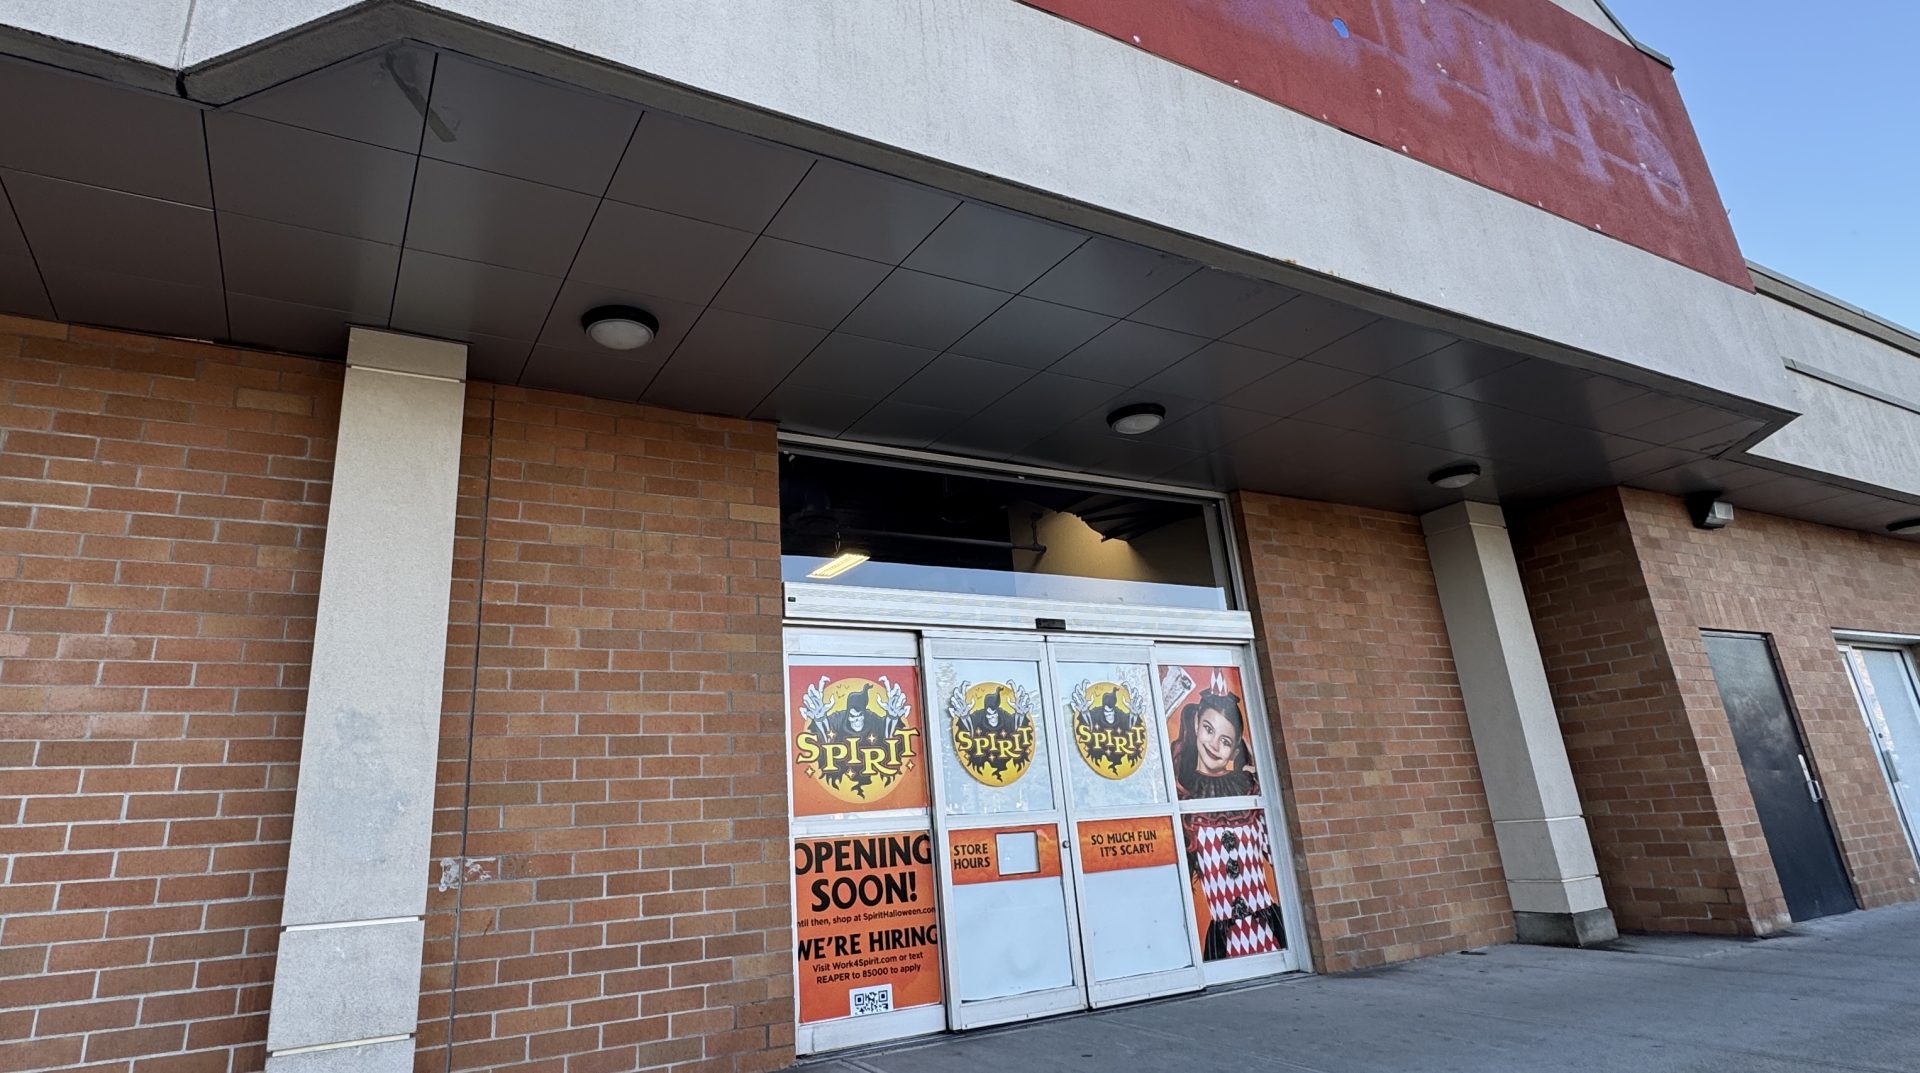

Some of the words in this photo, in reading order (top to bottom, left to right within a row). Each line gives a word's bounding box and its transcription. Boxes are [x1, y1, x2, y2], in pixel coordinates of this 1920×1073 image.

[958, 726, 1033, 759] SPIRIT
[1078, 724, 1147, 754] SPIRIT
[796, 728, 920, 775] SPIRIT
[1091, 834, 1104, 845] SO
[1107, 832, 1135, 843] MUCH
[1138, 829, 1157, 841] FUN
[795, 833, 932, 875] OPENING
[953, 843, 989, 856] STORE
[1100, 846, 1118, 857] IT'S
[1120, 842, 1154, 856] SCARY!
[954, 856, 991, 870] HOURS
[811, 871, 918, 912] SOON!
[797, 918, 809, 928] ntil
[811, 917, 831, 927] then,
[833, 915, 852, 924] shop
[853, 914, 862, 922] at
[798, 933, 862, 962] WE'RE
[869, 924, 938, 952] HIRING
[812, 964, 830, 973] Visit
[832, 956, 898, 970] Work4Spirit.com
[908, 951, 924, 960] text
[816, 972, 850, 984] REAPER
[852, 971, 861, 979] to
[862, 967, 889, 978] 85000
[900, 963, 921, 974] apply
